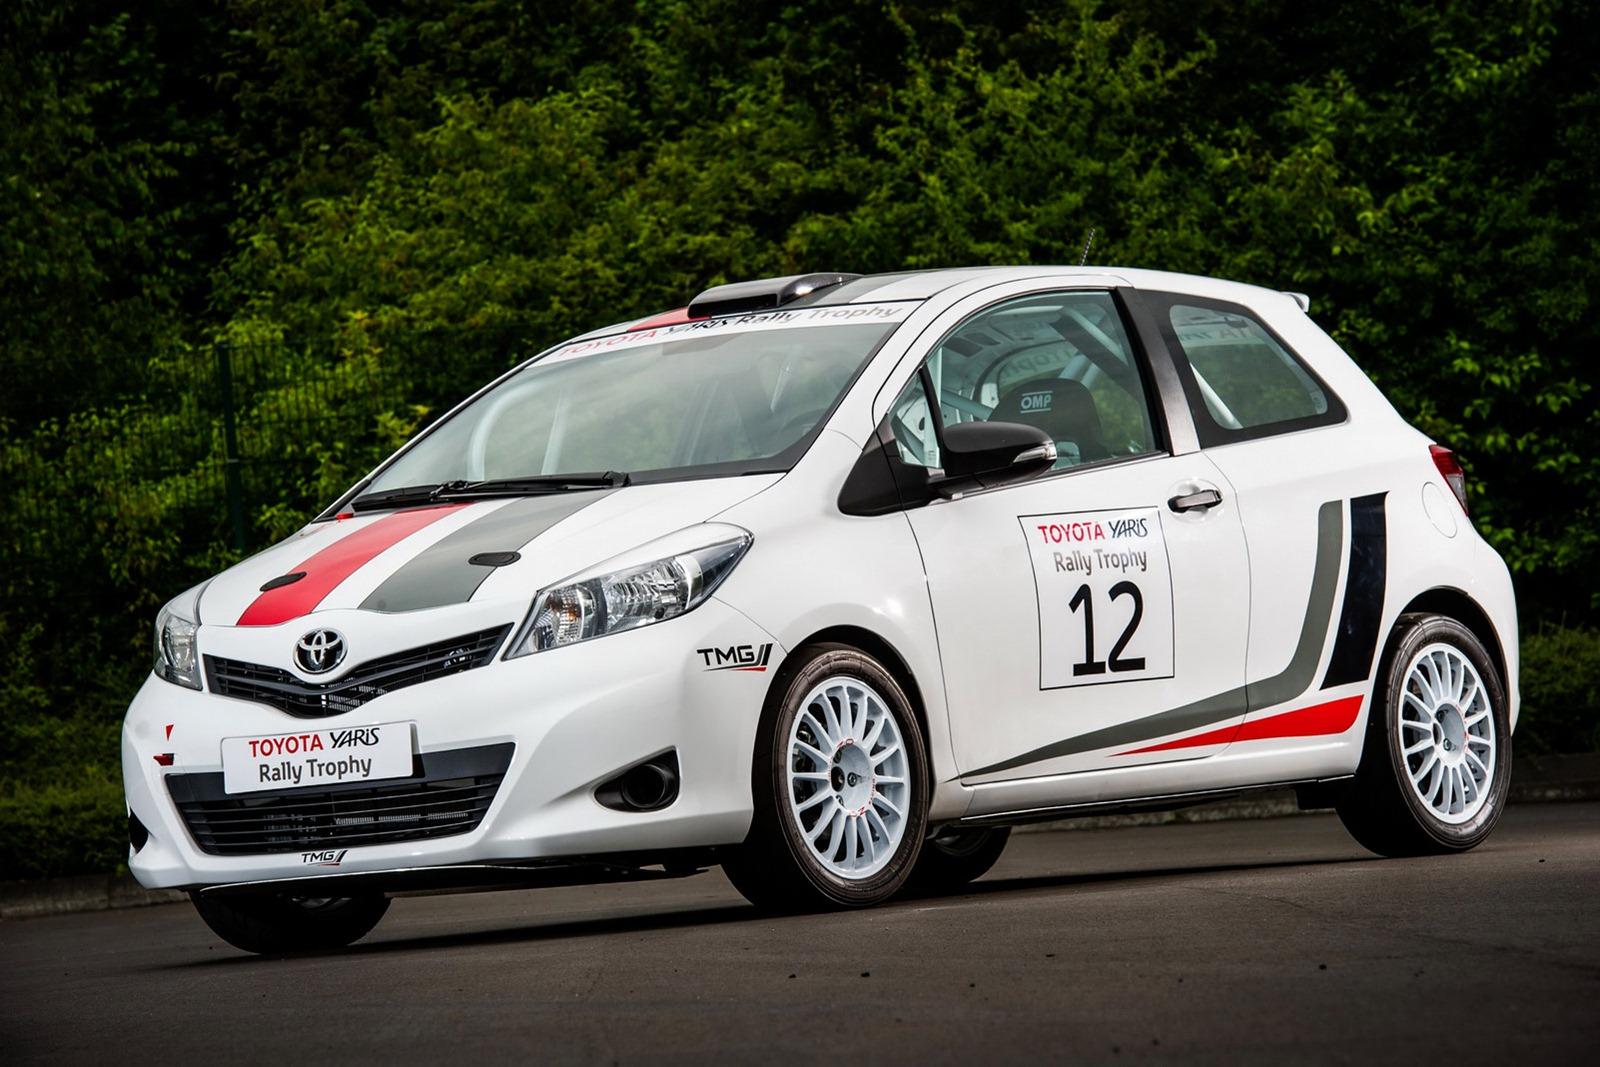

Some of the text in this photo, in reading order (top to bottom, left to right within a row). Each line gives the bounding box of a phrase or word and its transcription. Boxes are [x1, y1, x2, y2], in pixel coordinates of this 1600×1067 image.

[560, 330, 658, 356] TOYOTA
[735, 310, 801, 326] Rally
[808, 305, 903, 320] Trophy
[1020, 394, 1052, 410] OMP
[1038, 521, 1105, 544] TOYOTA
[1053, 547, 1147, 576] Rally Trophy
[1068, 580, 1146, 677] 12
[696, 644, 756, 666] TMG
[249, 734, 324, 758] TOYOTA
[259, 755, 372, 784] Rally Trophy
[301, 850, 336, 864] TMG
